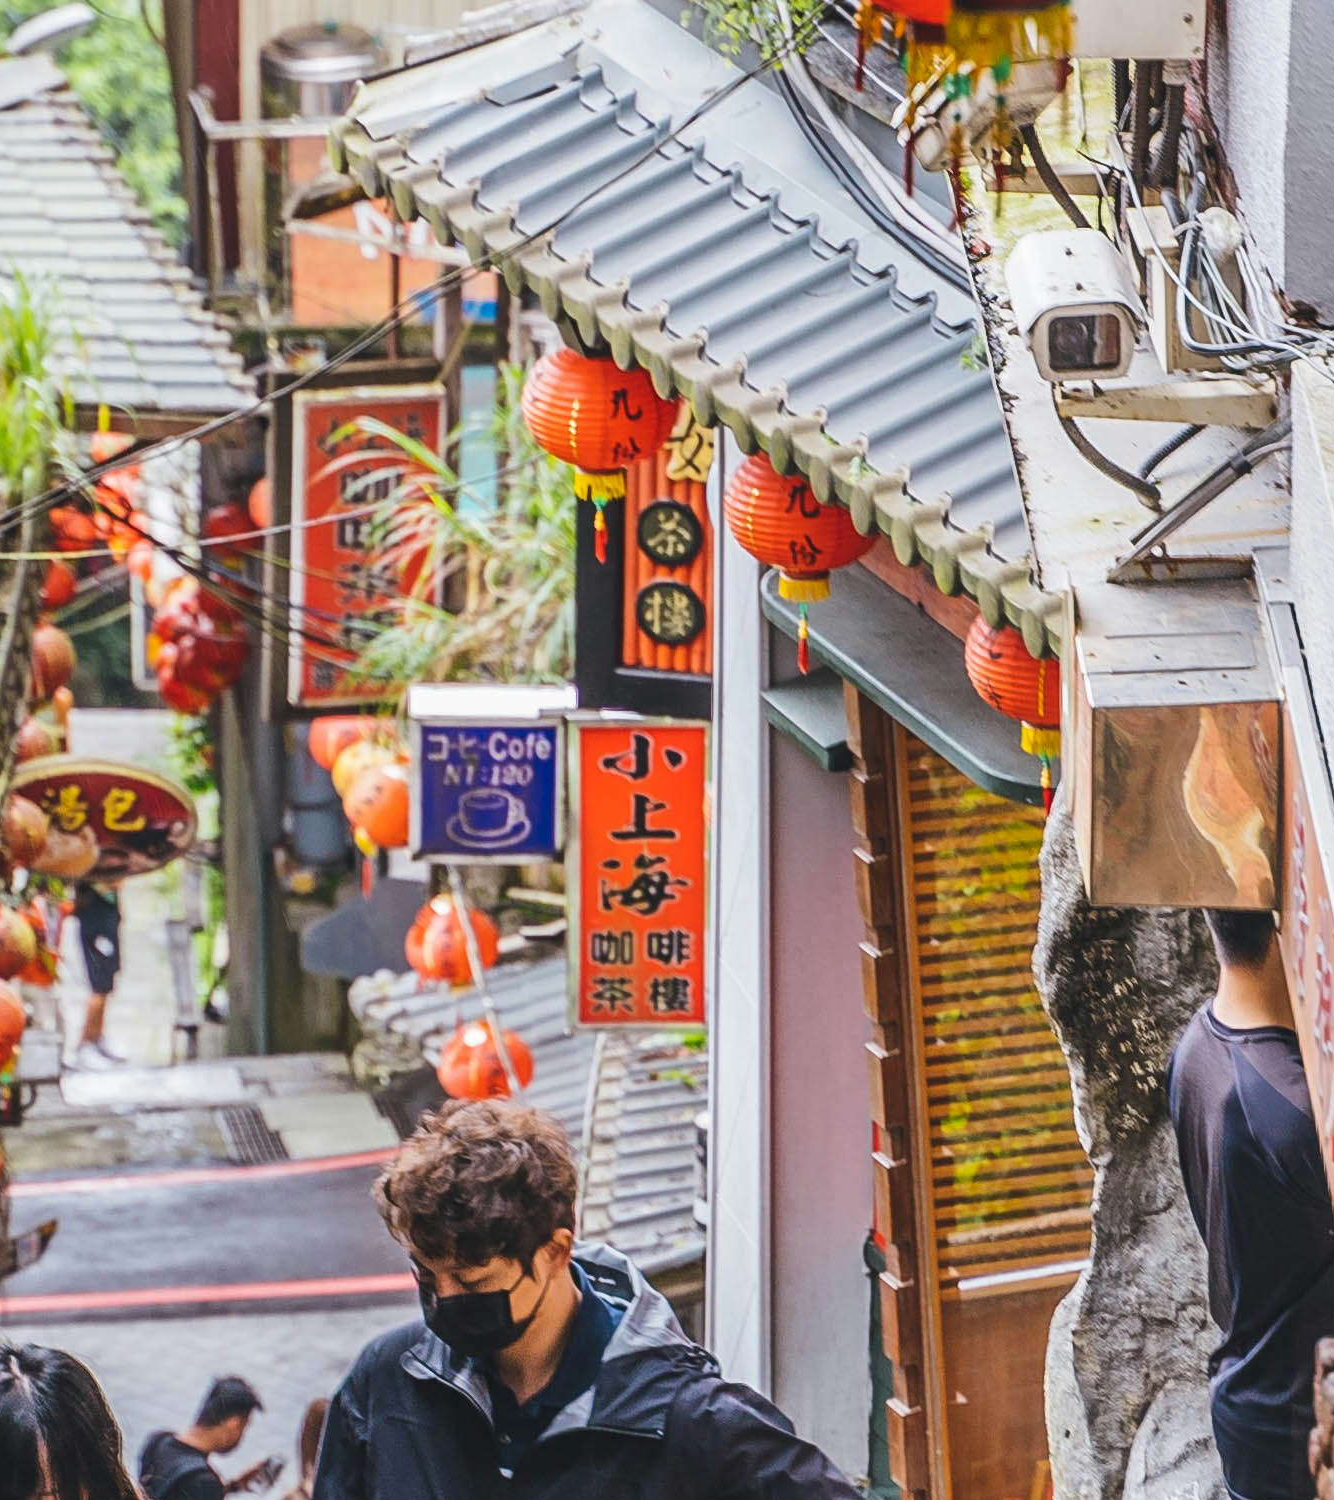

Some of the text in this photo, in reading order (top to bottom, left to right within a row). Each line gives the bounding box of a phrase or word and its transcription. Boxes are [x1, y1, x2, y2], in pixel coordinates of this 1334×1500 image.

[610, 388, 643, 464] 九份
[783, 485, 823, 567] 九份
[600, 732, 690, 917] 小上海
[590, 929, 692, 966] 咖啡
[590, 976, 692, 1014] 茶樓
